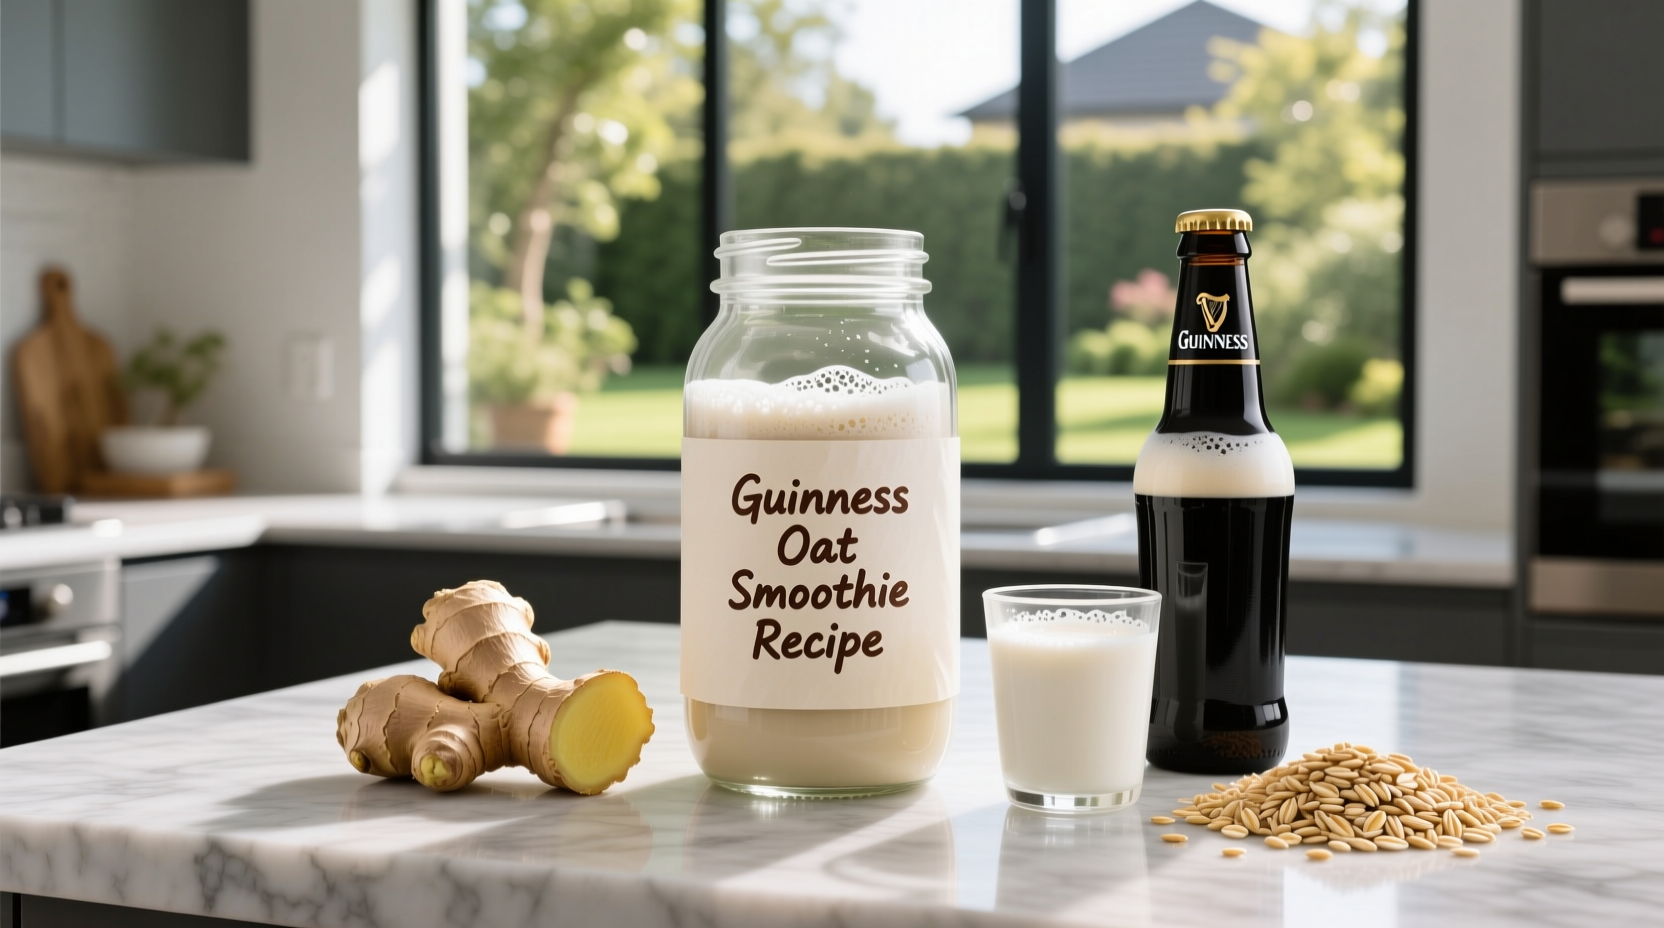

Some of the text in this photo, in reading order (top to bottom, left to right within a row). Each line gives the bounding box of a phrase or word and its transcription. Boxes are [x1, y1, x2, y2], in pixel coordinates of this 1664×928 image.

[1178, 330, 1249, 349] GUINNESS
[731, 473, 909, 525] Guinness
[777, 524, 859, 566] Oat
[728, 568, 910, 610] Smoothie
[752, 618, 884, 674] Recipe
